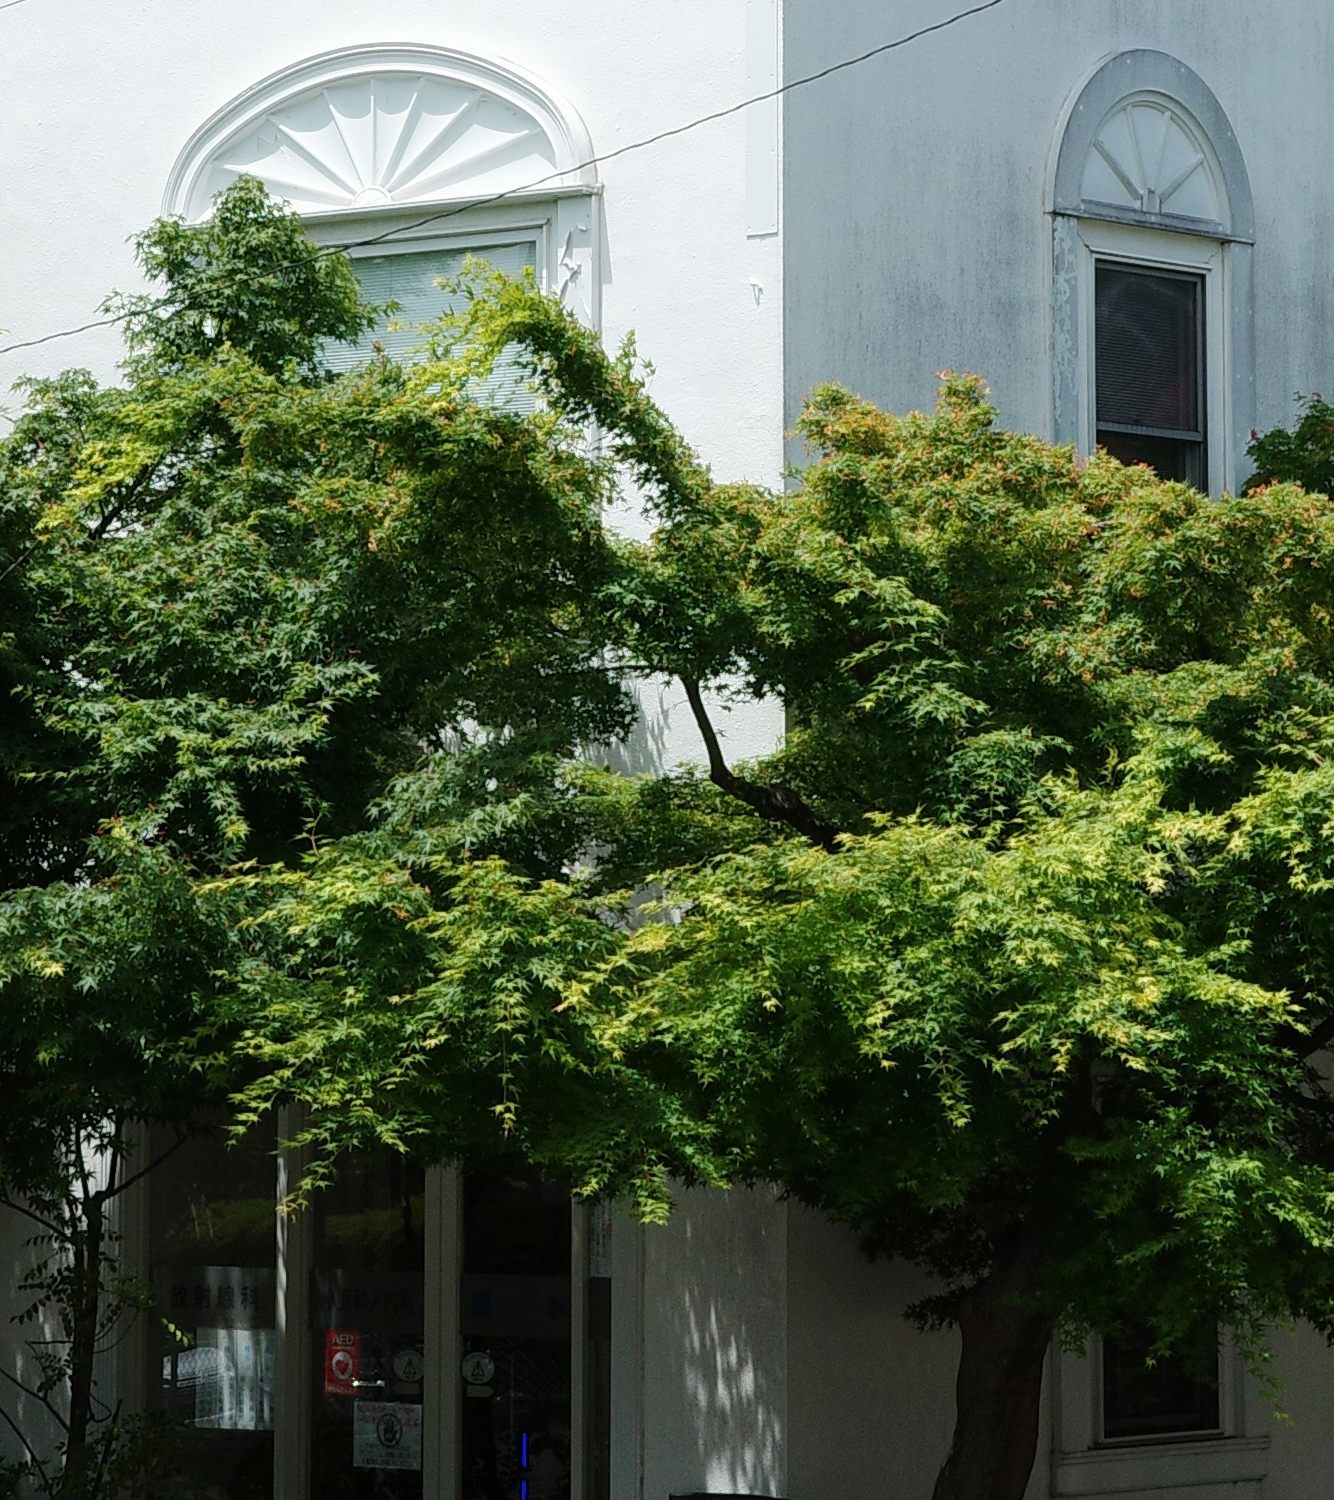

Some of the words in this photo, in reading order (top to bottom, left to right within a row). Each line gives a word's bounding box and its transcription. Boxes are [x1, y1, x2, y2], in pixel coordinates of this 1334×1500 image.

[170, 1285, 259, 1310] 放射線科
[331, 1334, 355, 1346] AED
